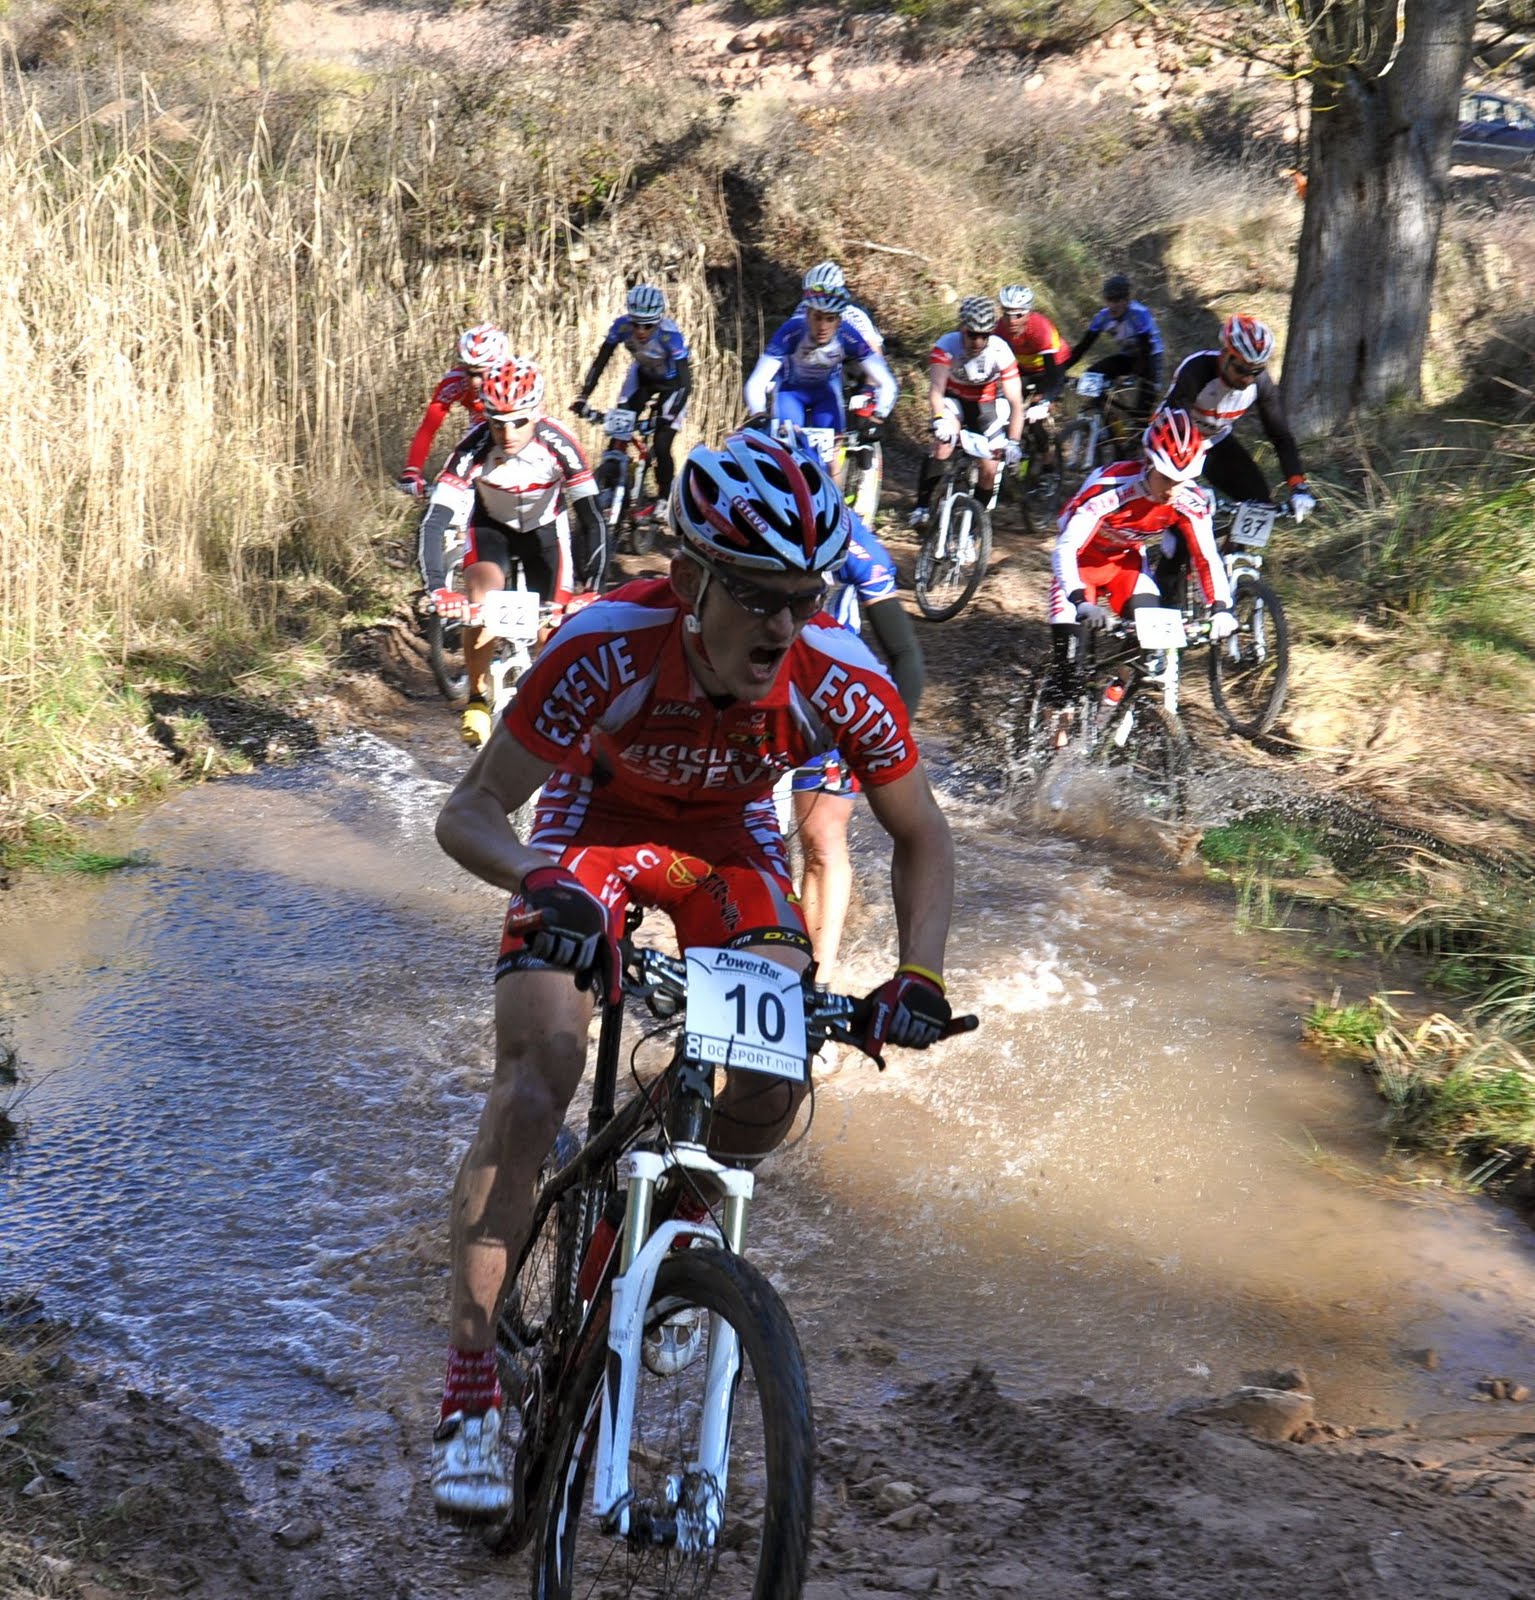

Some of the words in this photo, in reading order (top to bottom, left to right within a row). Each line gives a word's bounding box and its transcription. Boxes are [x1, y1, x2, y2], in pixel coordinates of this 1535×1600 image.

[731, 496, 769, 536] ESTEVE
[1241, 517, 1267, 538] 87
[499, 605, 525, 626] 22
[534, 636, 638, 747] ESTEVE
[810, 663, 907, 773] ESTEVE
[621, 759, 783, 789] STEV
[715, 952, 782, 981] PowerBar
[724, 983, 786, 1043] 10
[707, 1044, 799, 1074] OCSPORT.net
